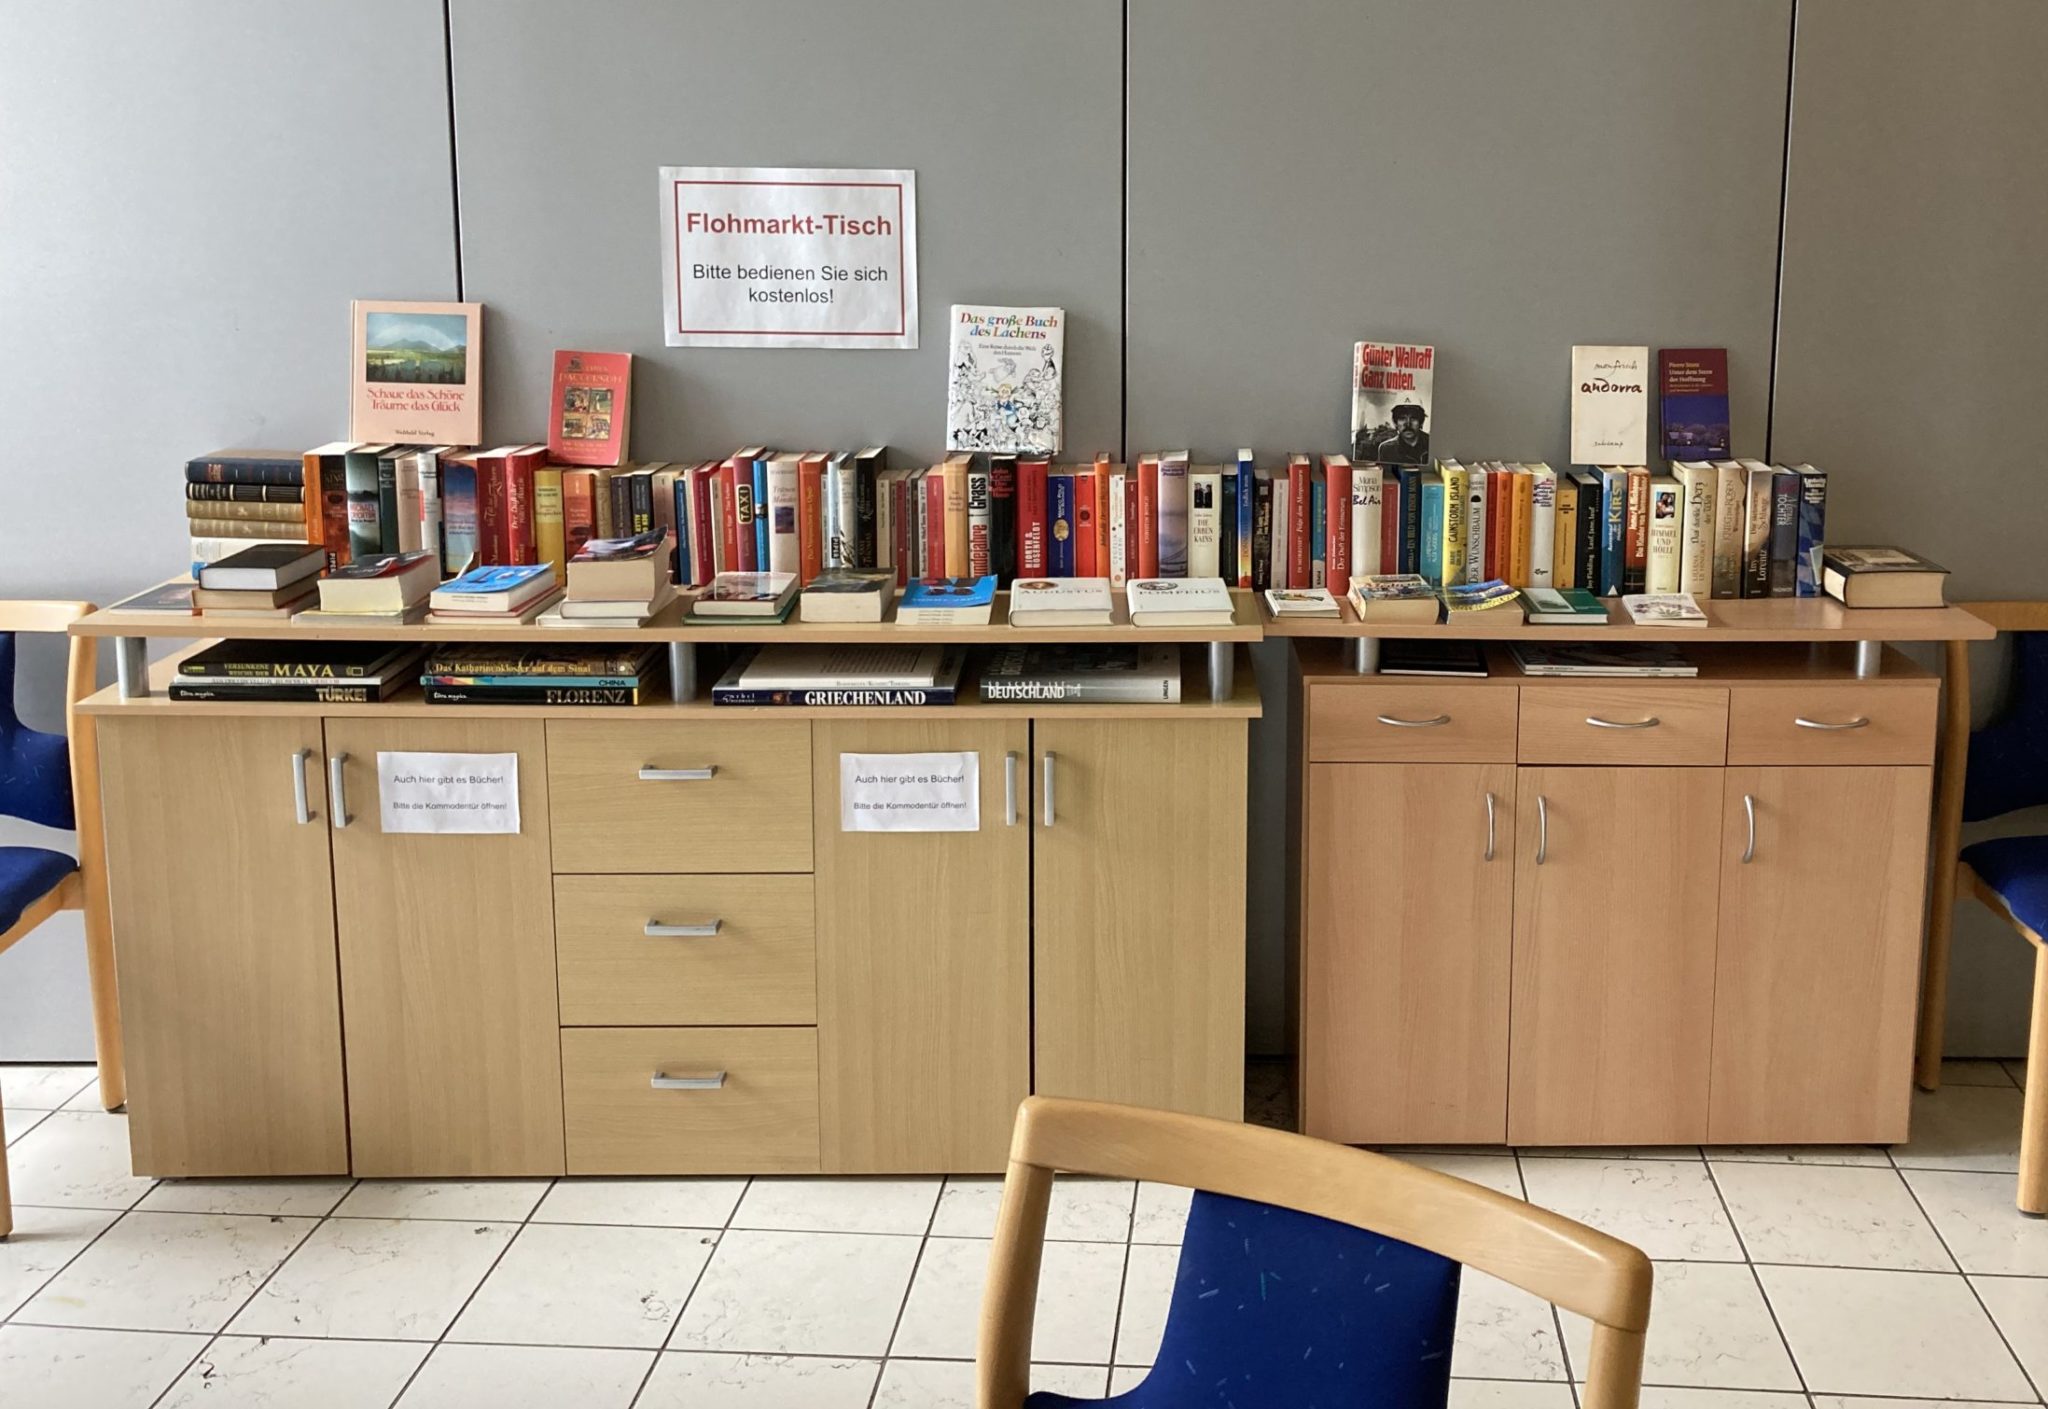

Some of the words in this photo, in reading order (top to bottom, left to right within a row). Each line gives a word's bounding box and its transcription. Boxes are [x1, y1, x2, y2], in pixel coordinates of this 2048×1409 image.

[687, 212, 892, 235] Flohmarkt-Tisch
[693, 264, 732, 279] Bitte
[737, 264, 815, 280] bedienen
[821, 266, 848, 281] Sie
[854, 266, 888, 282] sich
[749, 288, 834, 304] kostenlos!
[960, 312, 984, 324] Das
[988, 316, 1022, 328] große
[1025, 316, 1058, 328] Buch
[970, 326, 991, 336] des
[992, 327, 1046, 339] Lachens
[1362, 344, 1393, 366] Günter
[1395, 346, 1432, 370] Wallraff
[1362, 366, 1384, 388] Ganz
[1386, 369, 1416, 390] unten.
[1581, 378, 1642, 394] andorra
[1679, 376, 1706, 384] Hoffnung
[368, 388, 404, 399] Schaue
[406, 388, 425, 400] das
[426, 389, 464, 400] Schöne
[372, 399, 409, 411] Träume
[411, 400, 430, 411] das
[431, 400, 460, 412] Glück
[1359, 476, 1377, 484] Mona
[970, 478, 986, 509] Grass
[1354, 484, 1381, 494] Simpson
[1450, 477, 1460, 500] ISLAND
[1630, 476, 1639, 504] Michener
[1692, 482, 1708, 506] Herz
[740, 489, 750, 520] TAXI
[1352, 495, 1366, 506] Bel
[1368, 496, 1381, 505] Air
[1608, 480, 1622, 523] KIRST
[1777, 494, 1787, 526] TOCHTER
[1448, 504, 1459, 542] CAINSTORM
[1629, 511, 1638, 530] James
[1637, 526, 1645, 546] Kinder
[1650, 529, 1676, 538] HIMMEL
[972, 524, 989, 576] undejahre
[1032, 522, 1040, 568] ROSENFELDT
[1656, 538, 1671, 546] UND
[1636, 547, 1644, 558] Die
[1750, 559, 1758, 572] Iny
[1757, 550, 1767, 580] Lorentz
[274, 664, 334, 677] MAYA
[435, 664, 452, 673] Das
[454, 664, 529, 674] Katharinenkloster
[532, 664, 545, 673] auf
[550, 664, 566, 673] dem
[568, 664, 590, 673] Sinai
[316, 686, 367, 702] TÜRKEI
[546, 690, 626, 704] FLORENZ
[804, 691, 926, 705] GRIECHENLAND
[988, 684, 1065, 698] DEUTSCHLAND
[394, 776, 417, 784] Auch
[420, 776, 435, 784] hier
[438, 776, 454, 785] gibt
[470, 776, 504, 784] Bücher!
[855, 775, 878, 783] Auch
[880, 775, 896, 783] hier
[899, 776, 916, 784] gibt
[930, 774, 964, 783] Bücher!
[426, 802, 479, 810] Kommodentür
[481, 802, 508, 810] öffnen!
